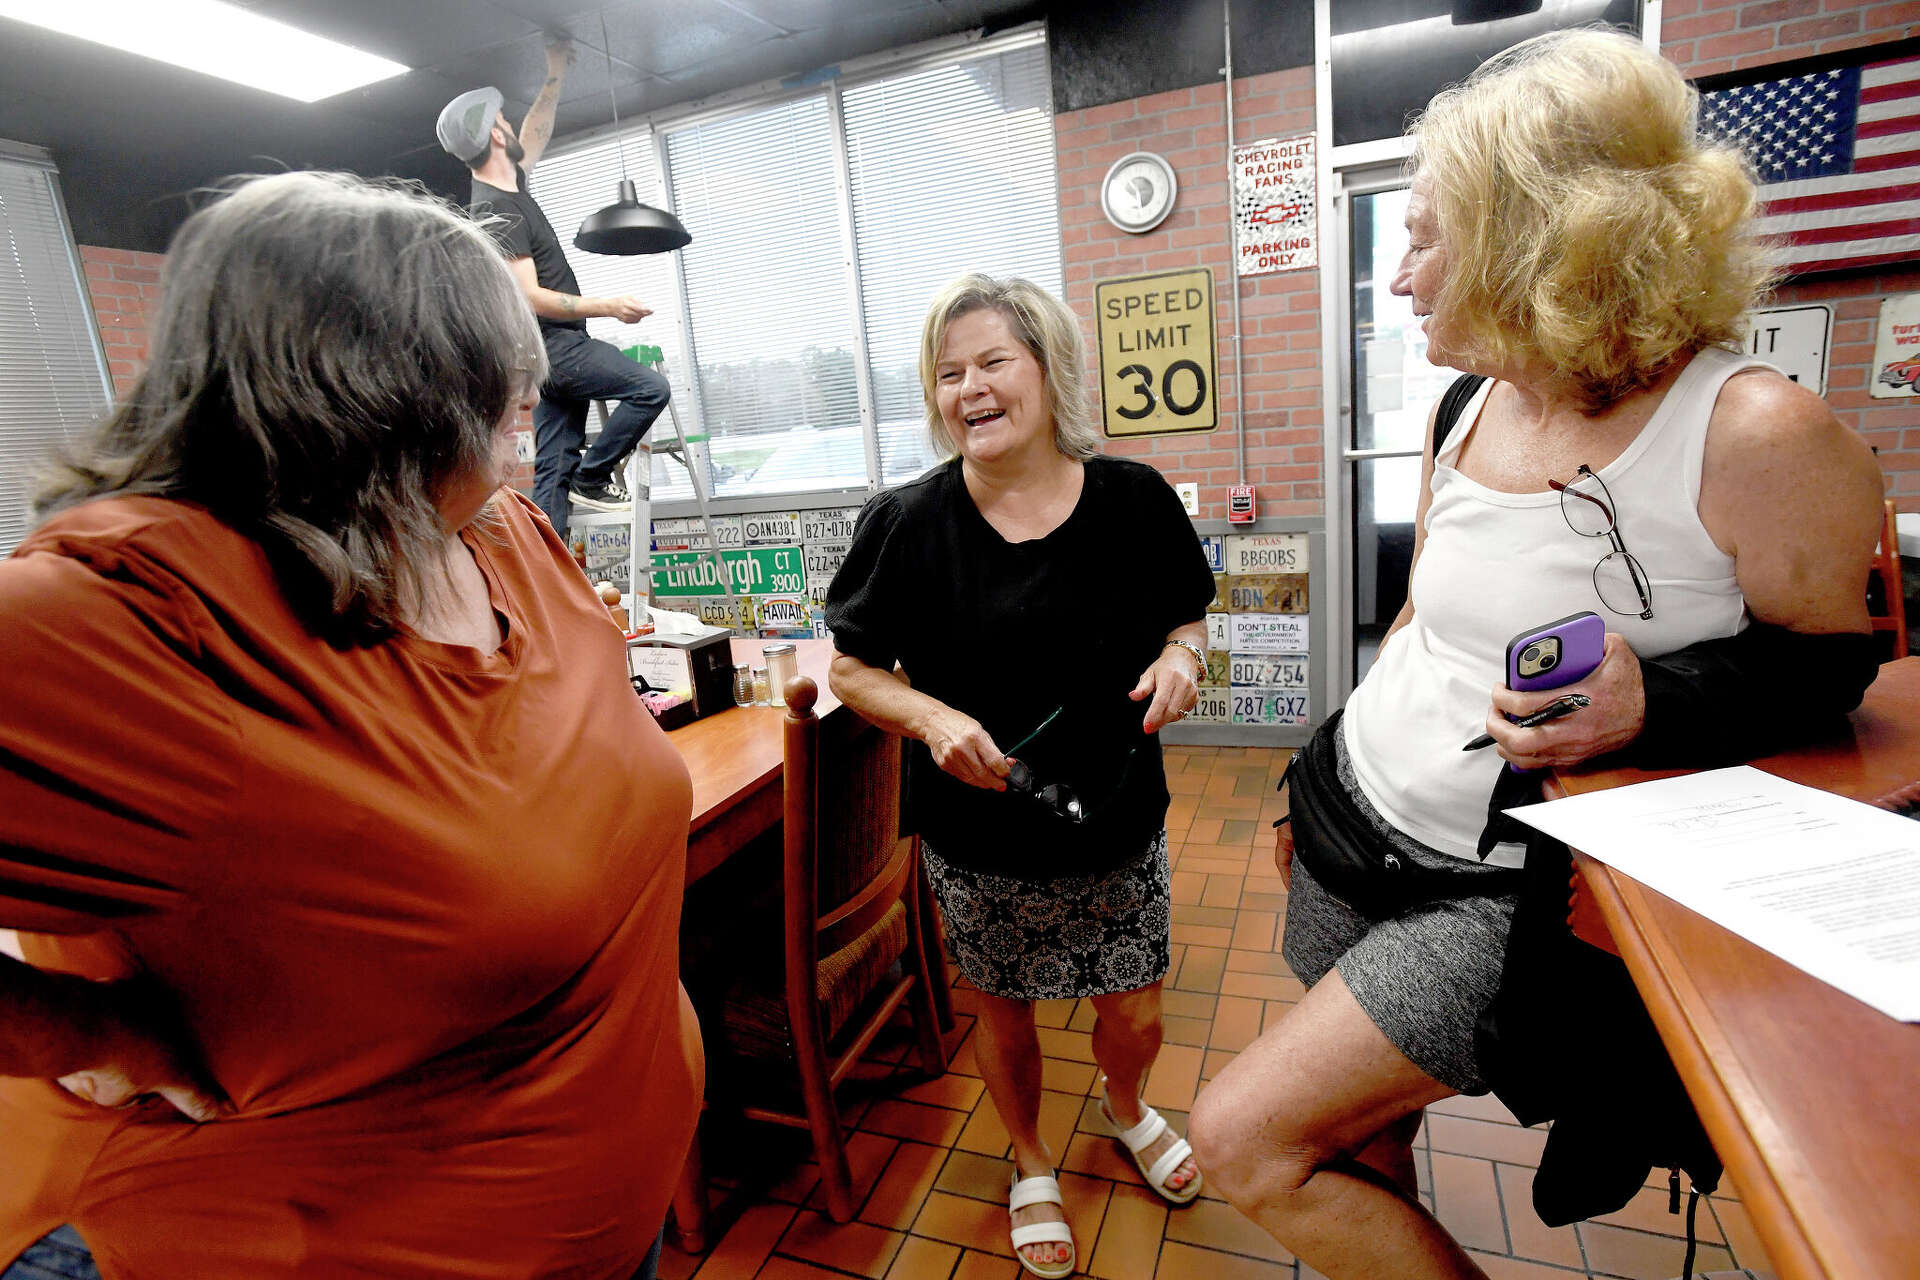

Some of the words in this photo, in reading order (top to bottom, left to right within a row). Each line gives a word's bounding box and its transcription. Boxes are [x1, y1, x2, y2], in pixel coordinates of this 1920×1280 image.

[1235, 143, 1310, 164] CHEVROLET
[1245, 159, 1303, 176] RACING
[1255, 173, 1294, 189] FANS
[1242, 238, 1310, 256] PARKING
[1259, 253, 1295, 267] ONLY
[1107, 288, 1203, 319] SPEED
[1119, 324, 1191, 352] LIMIT
[1116, 359, 1206, 419] 30
[1231, 487, 1252, 496] FIRE
[1252, 537, 1281, 547] TEXAS
[775, 552, 789, 570] CT
[770, 574, 800, 592] 3900
[763, 604, 802, 620] HAWAII
[1237, 624, 1268, 632] DON'T
[1269, 624, 1302, 632] STEAL
[1234, 696, 1264, 716] 287
[1275, 696, 1306, 717] GXZ
